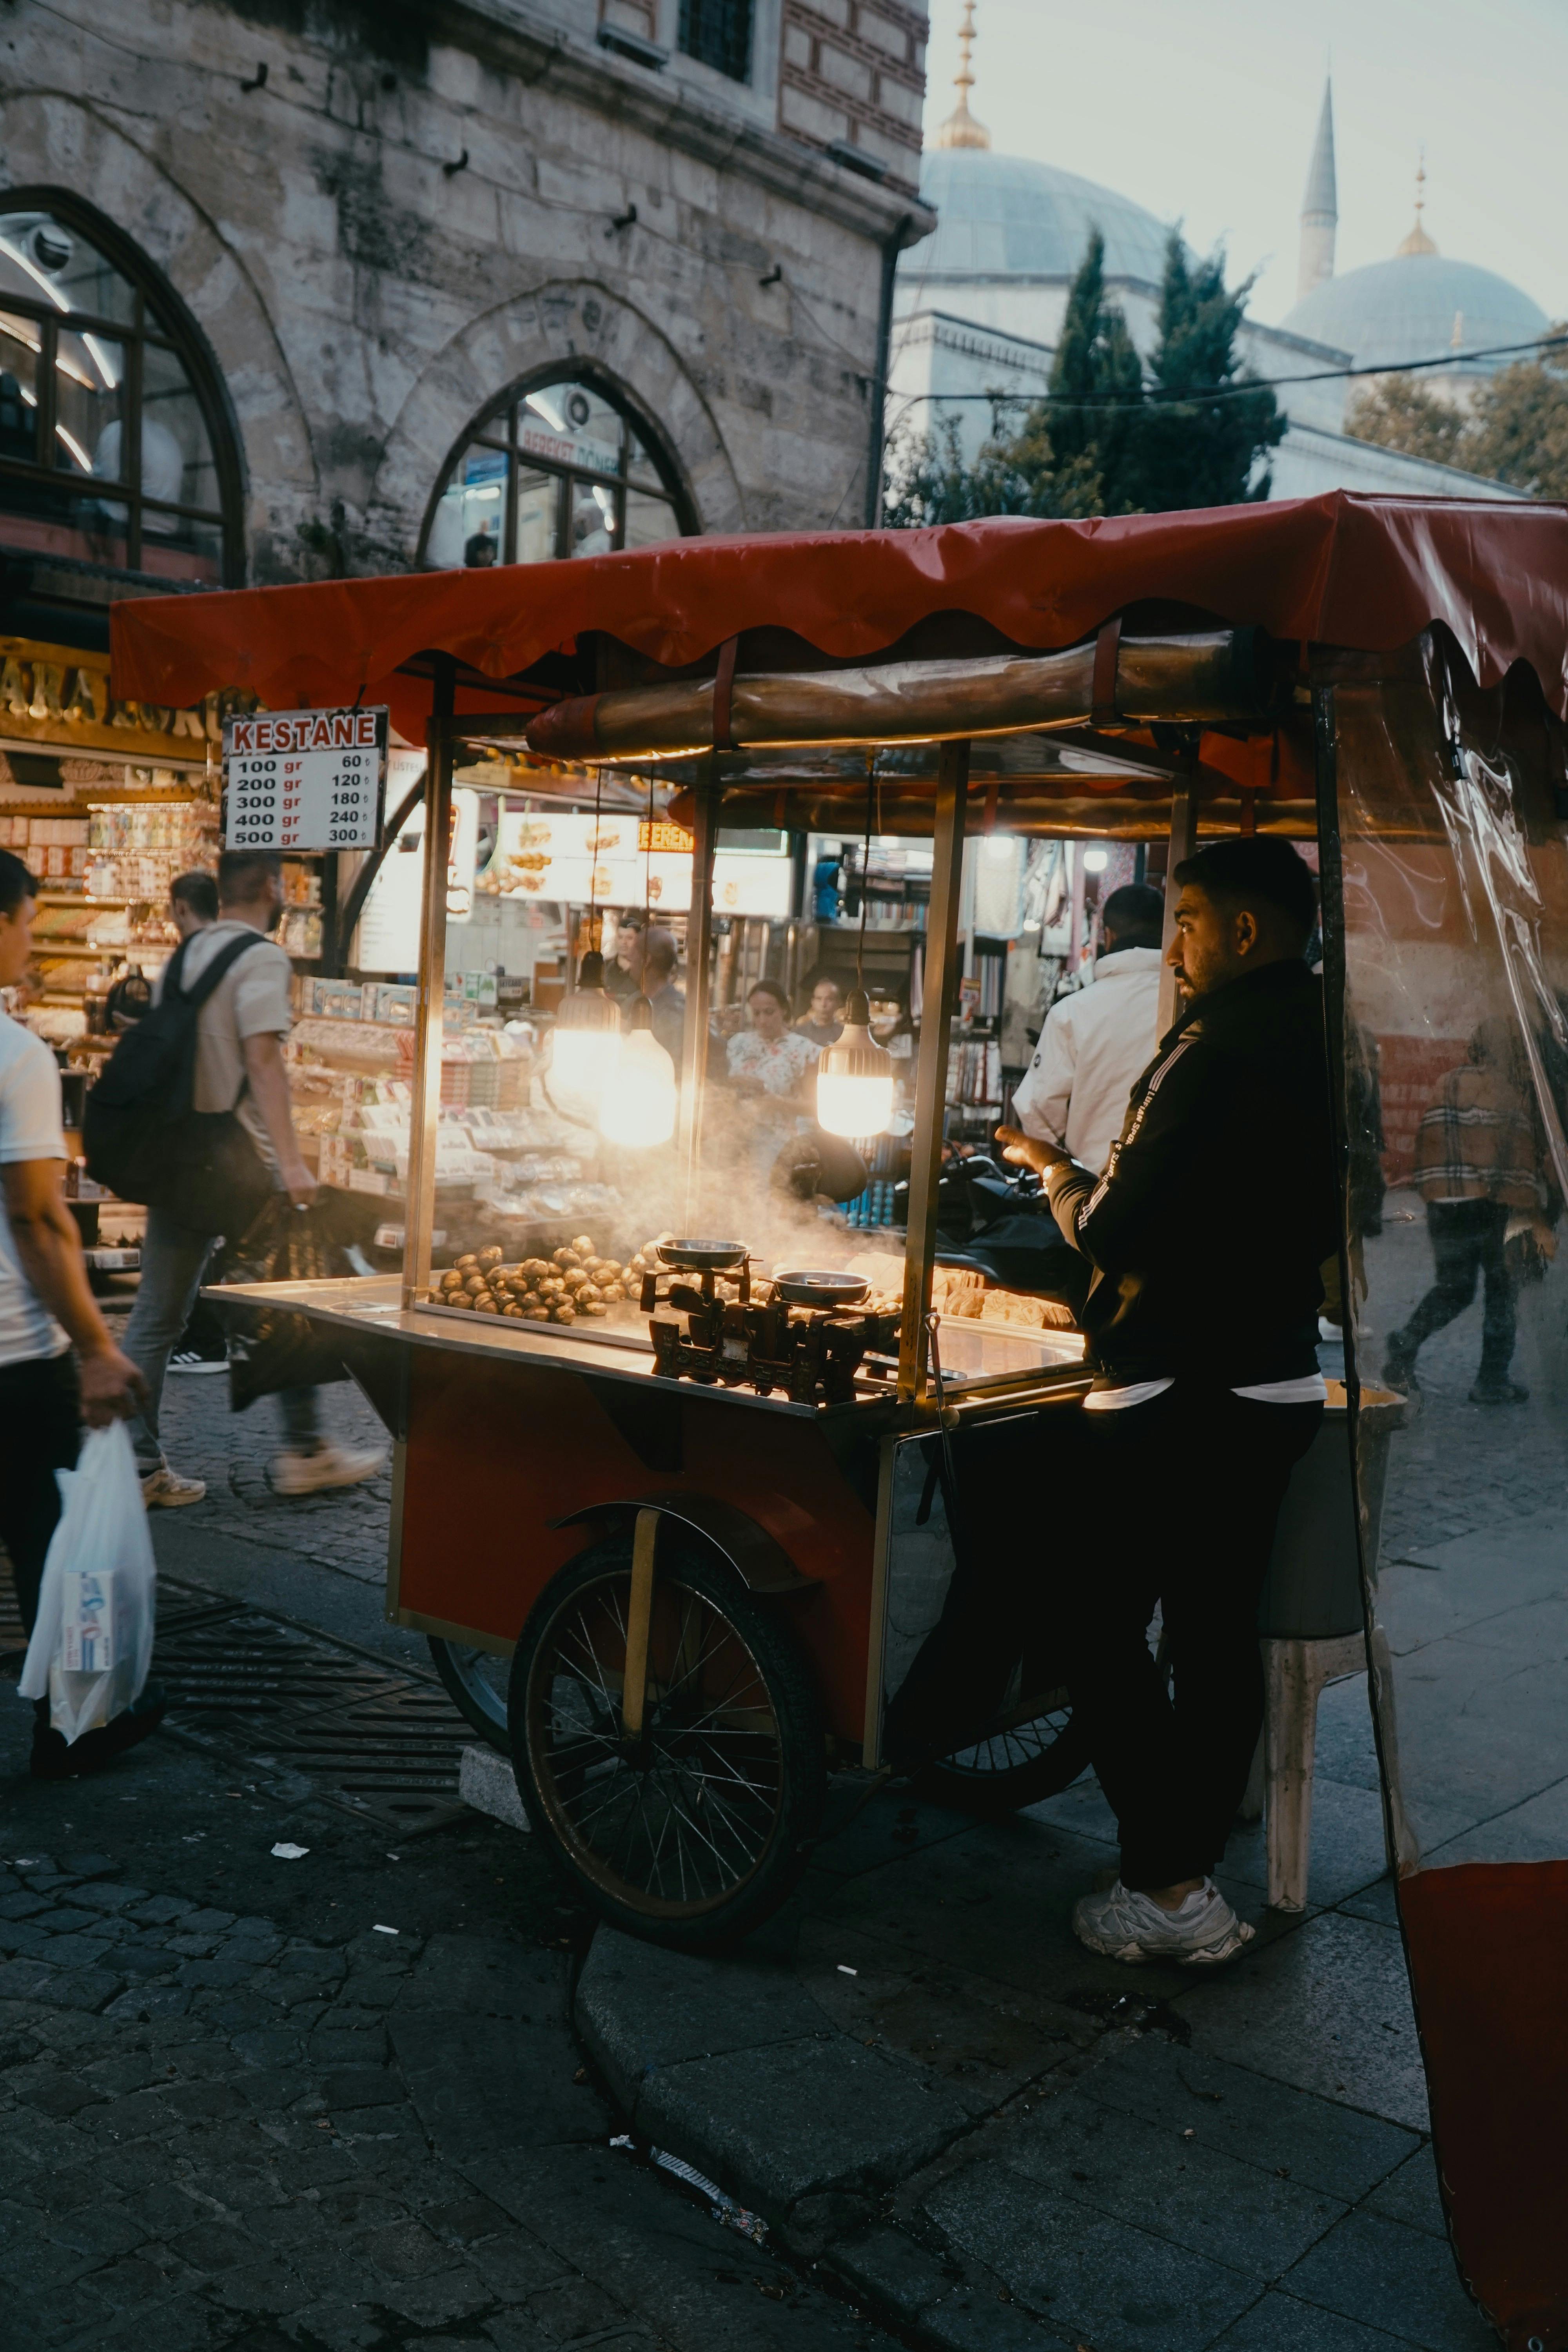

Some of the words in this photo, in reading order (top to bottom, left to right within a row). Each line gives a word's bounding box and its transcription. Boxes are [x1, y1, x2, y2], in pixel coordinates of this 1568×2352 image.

[234, 716, 375, 750] KESTANE
[239, 760, 276, 773] 100
[284, 761, 302, 774] gr
[342, 755, 361, 768] 60
[237, 778, 276, 791] 200
[283, 779, 301, 792] gr
[332, 774, 360, 786] 120
[237, 796, 275, 808] 300
[283, 797, 301, 810] gr
[332, 792, 359, 805] 180
[235, 814, 274, 826] 400
[282, 816, 300, 828] gr
[330, 811, 359, 823] 240
[235, 831, 273, 844] 500
[281, 833, 299, 846] gr
[329, 829, 358, 842] 300
[1136, 1091, 1155, 1123] LUFIAN
